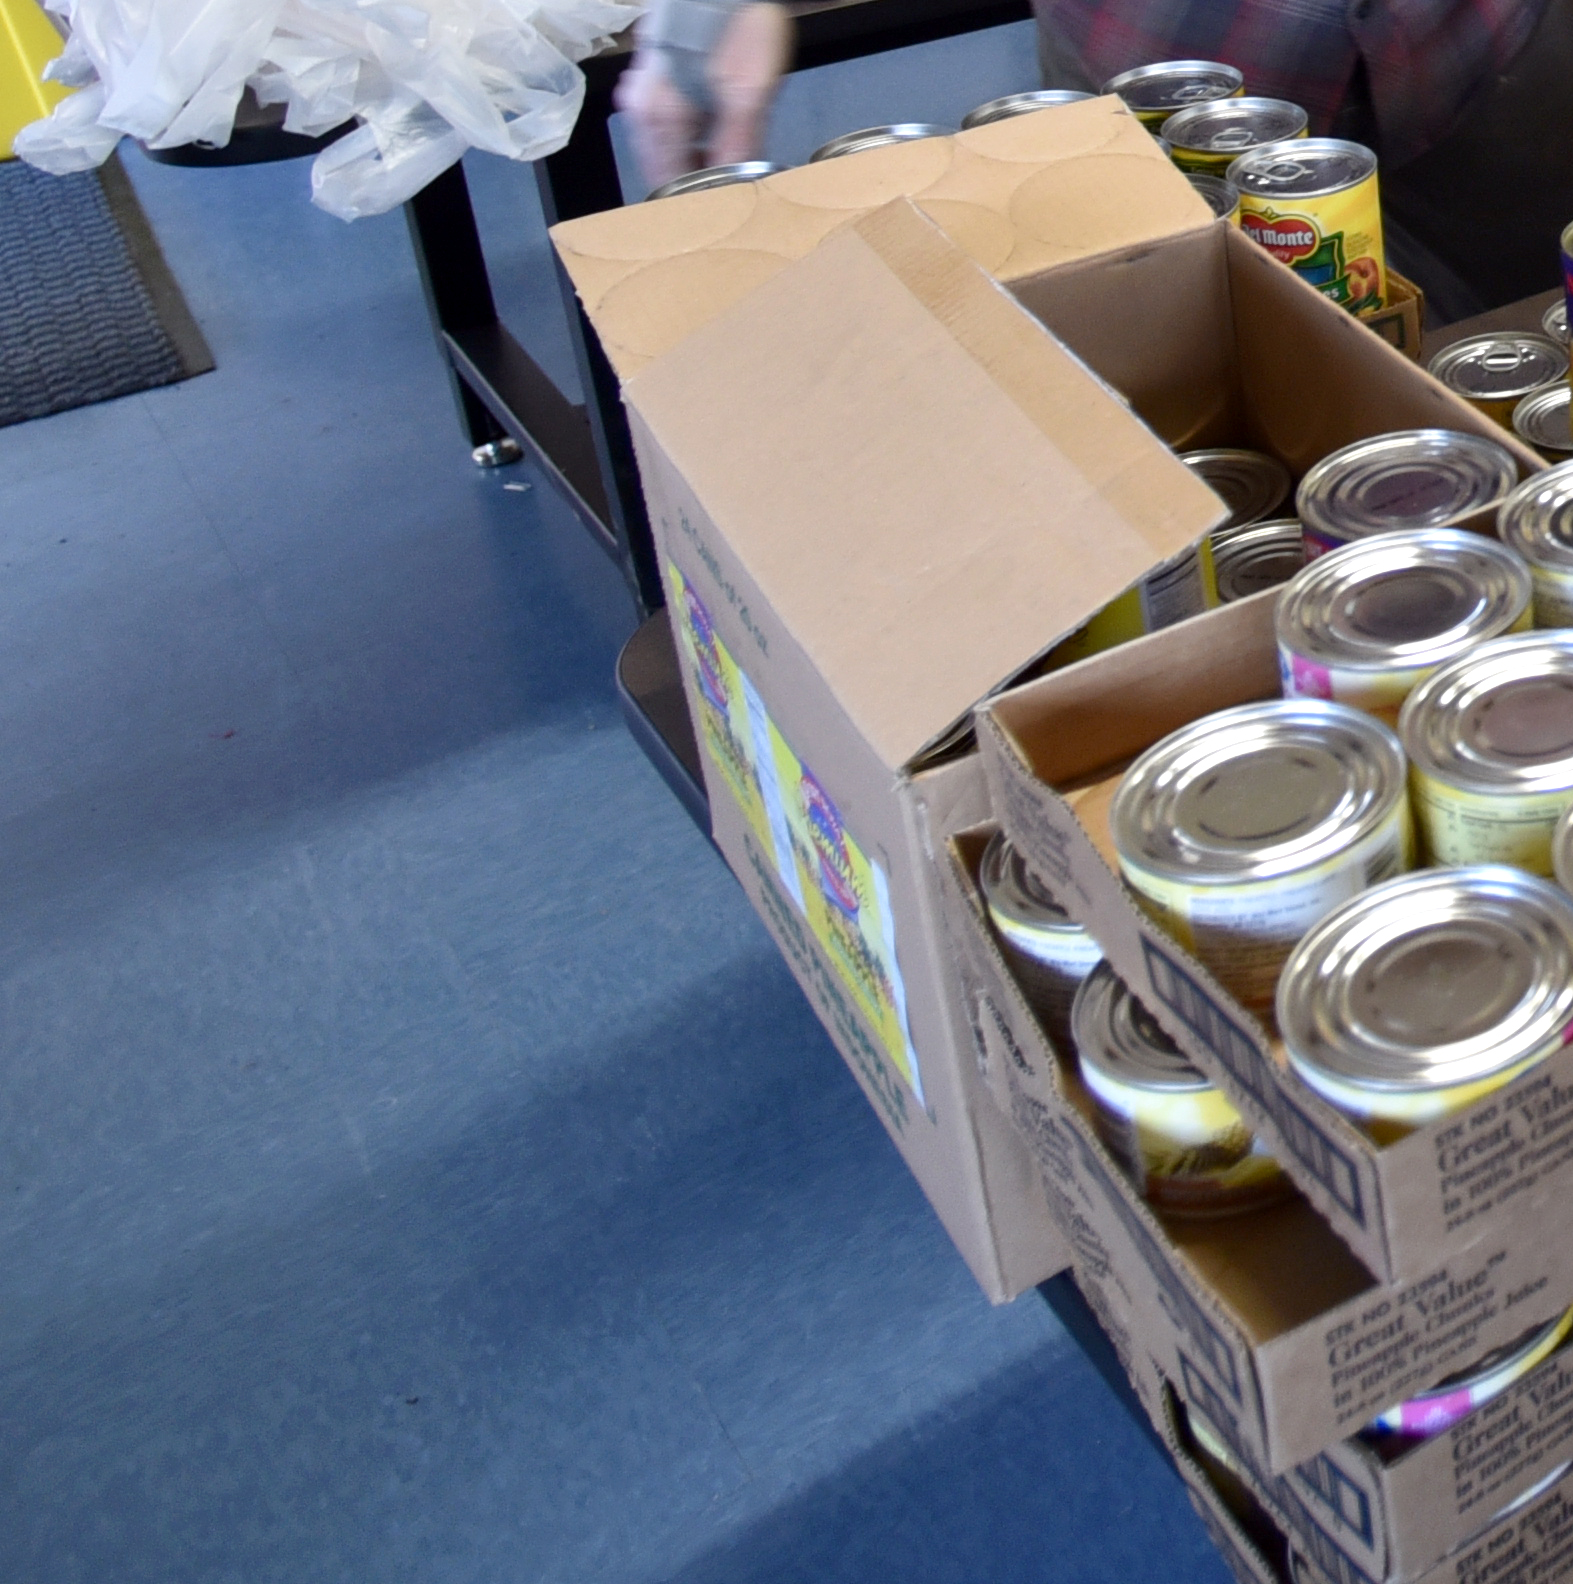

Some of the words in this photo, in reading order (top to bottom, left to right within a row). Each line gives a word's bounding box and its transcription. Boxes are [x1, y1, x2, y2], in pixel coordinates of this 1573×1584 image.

[1262, 229, 1314, 246] Monte
[1437, 1119, 1512, 1172] Great
[1327, 1315, 1406, 1367] Great
[1330, 1328, 1420, 1388] Pineapple
[1424, 1287, 1496, 1334] Chunks
[1412, 1304, 1499, 1362] Pineapple
[1503, 1275, 1549, 1310] Juice
[1452, 1404, 1520, 1462] Great
